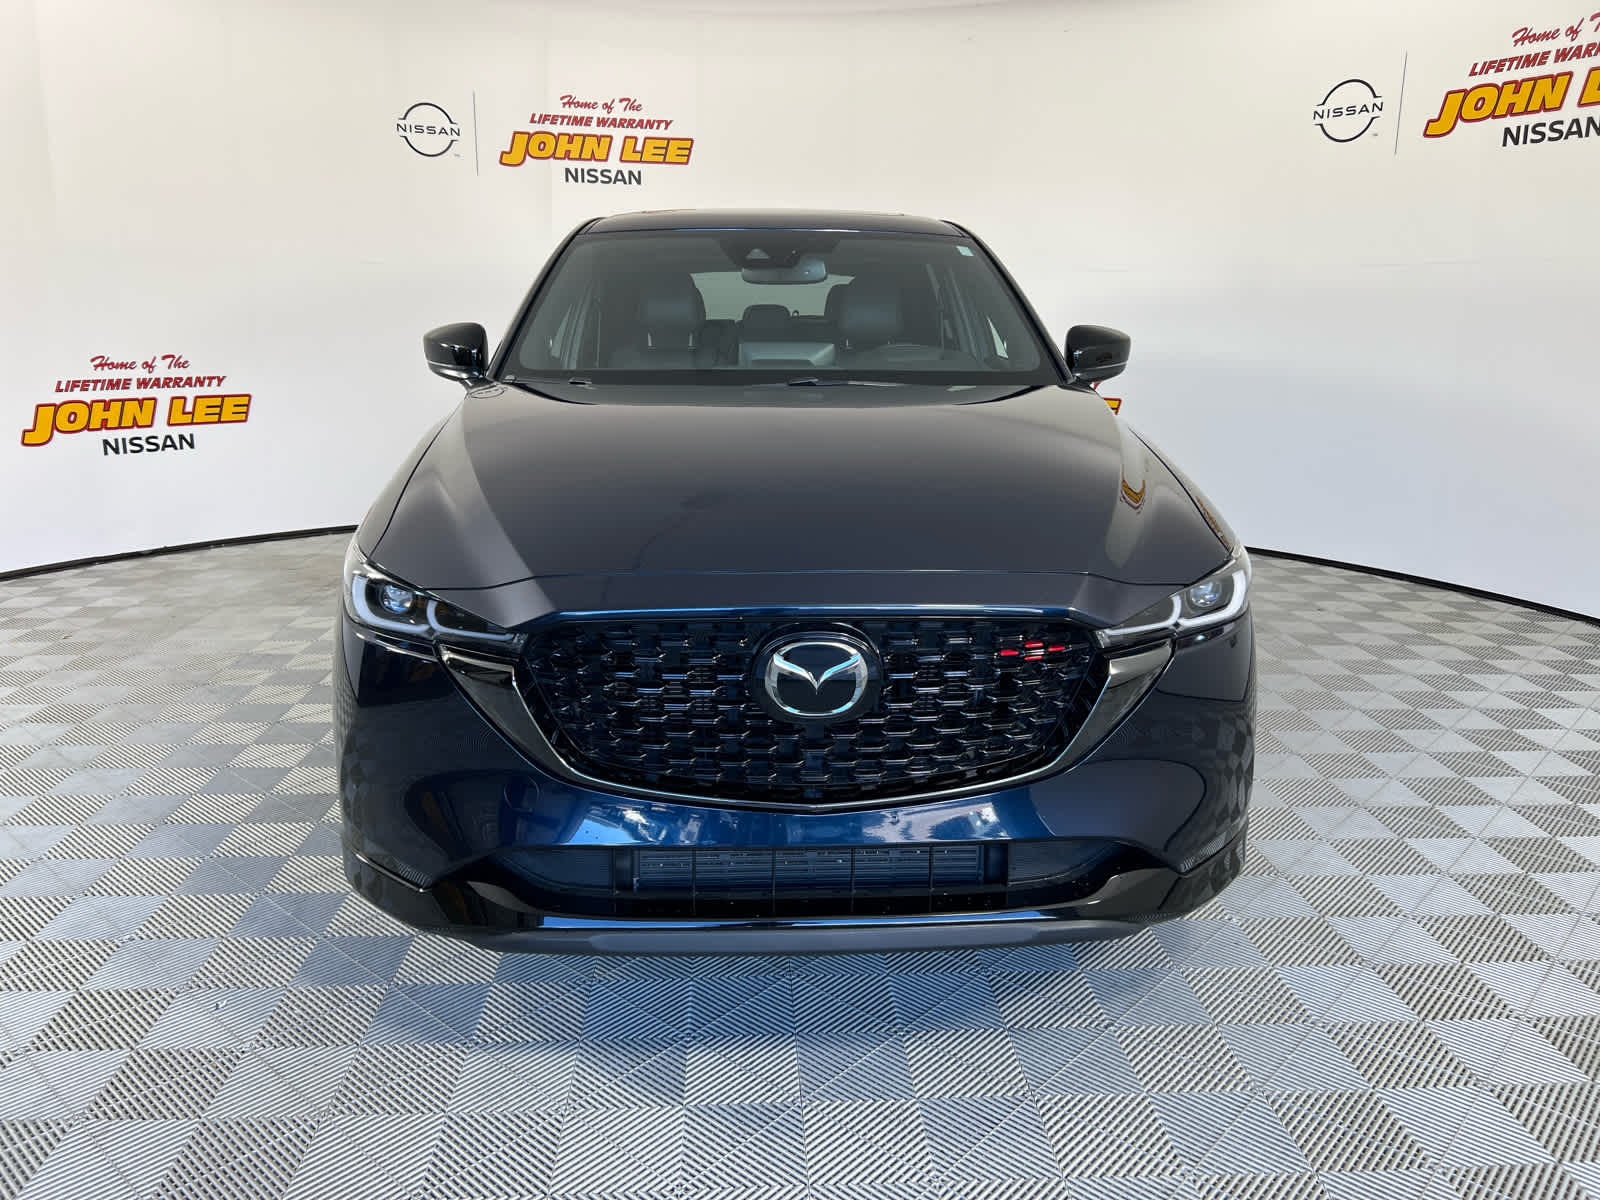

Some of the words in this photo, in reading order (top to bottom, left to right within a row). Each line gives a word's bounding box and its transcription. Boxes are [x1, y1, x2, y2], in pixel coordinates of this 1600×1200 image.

[1512, 27, 1560, 47] Home
[1565, 18, 1584, 42] of
[1468, 51, 1551, 77] LIFETIME
[560, 94, 598, 111] Home
[602, 99, 614, 113] of
[618, 97, 643, 112] The
[1313, 101, 1384, 121] NISSAN
[1423, 71, 1573, 138] JOHN
[396, 122, 460, 137] NISSAN
[529, 113, 593, 127] LIFETIME
[596, 116, 674, 130] WARRANTY
[1502, 115, 1600, 147] NISSAN
[499, 130, 613, 167] JOHN
[619, 136, 694, 165] LEE
[564, 167, 642, 186] NISSAN
[90, 355, 137, 371] Home
[141, 356, 156, 373] of
[161, 354, 190, 370] The
[55, 378, 132, 393] LIFETIME
[136, 375, 226, 390] WARRANTY
[21, 397, 158, 447] JOHN
[167, 393, 252, 427] LEE
[102, 433, 195, 456] NISSAN
